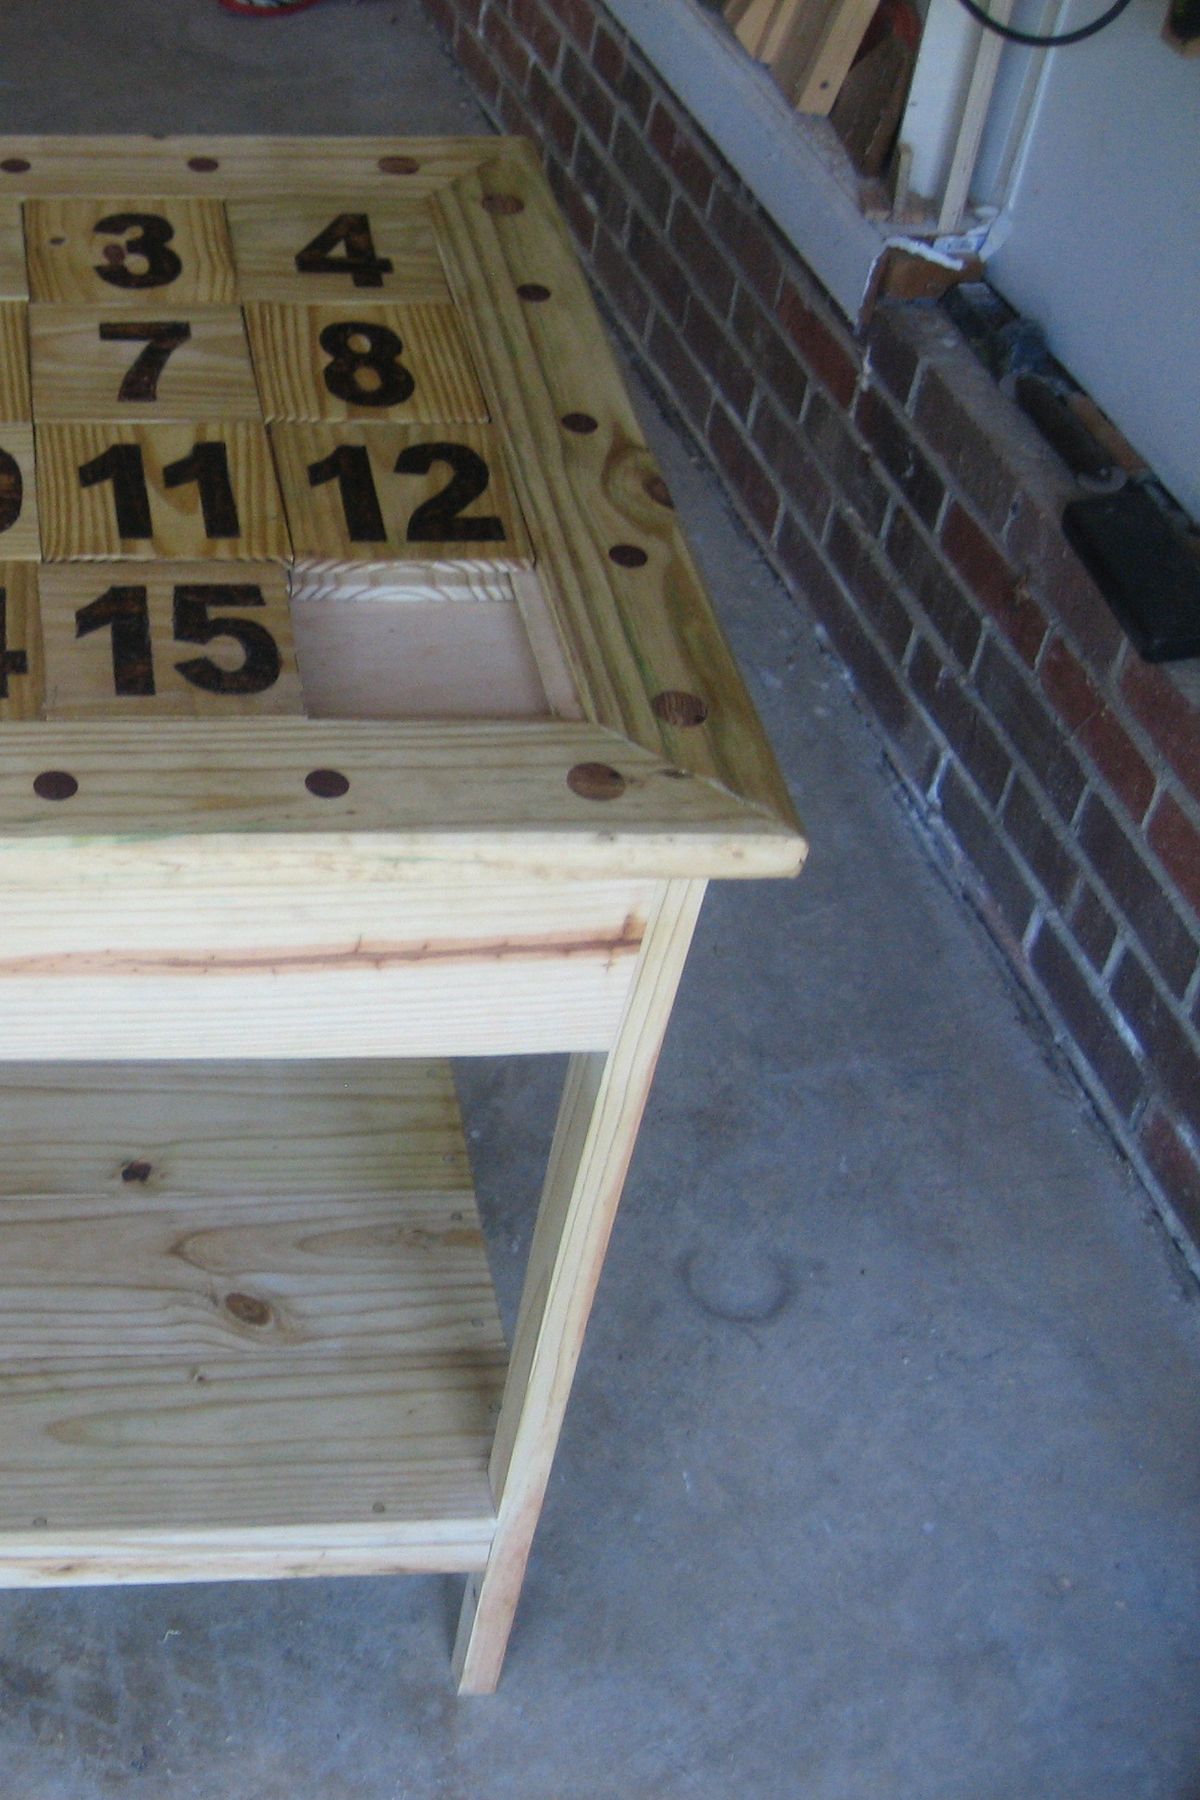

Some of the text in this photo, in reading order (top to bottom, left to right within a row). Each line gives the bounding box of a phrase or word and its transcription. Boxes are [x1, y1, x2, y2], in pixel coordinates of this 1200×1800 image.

[92, 212, 184, 288] 3
[294, 212, 394, 288] 4
[98, 321, 192, 402] 7
[324, 321, 417, 408] 8
[77, 441, 241, 540] 11
[307, 442, 505, 542] 12
[73, 584, 282, 697] 15
